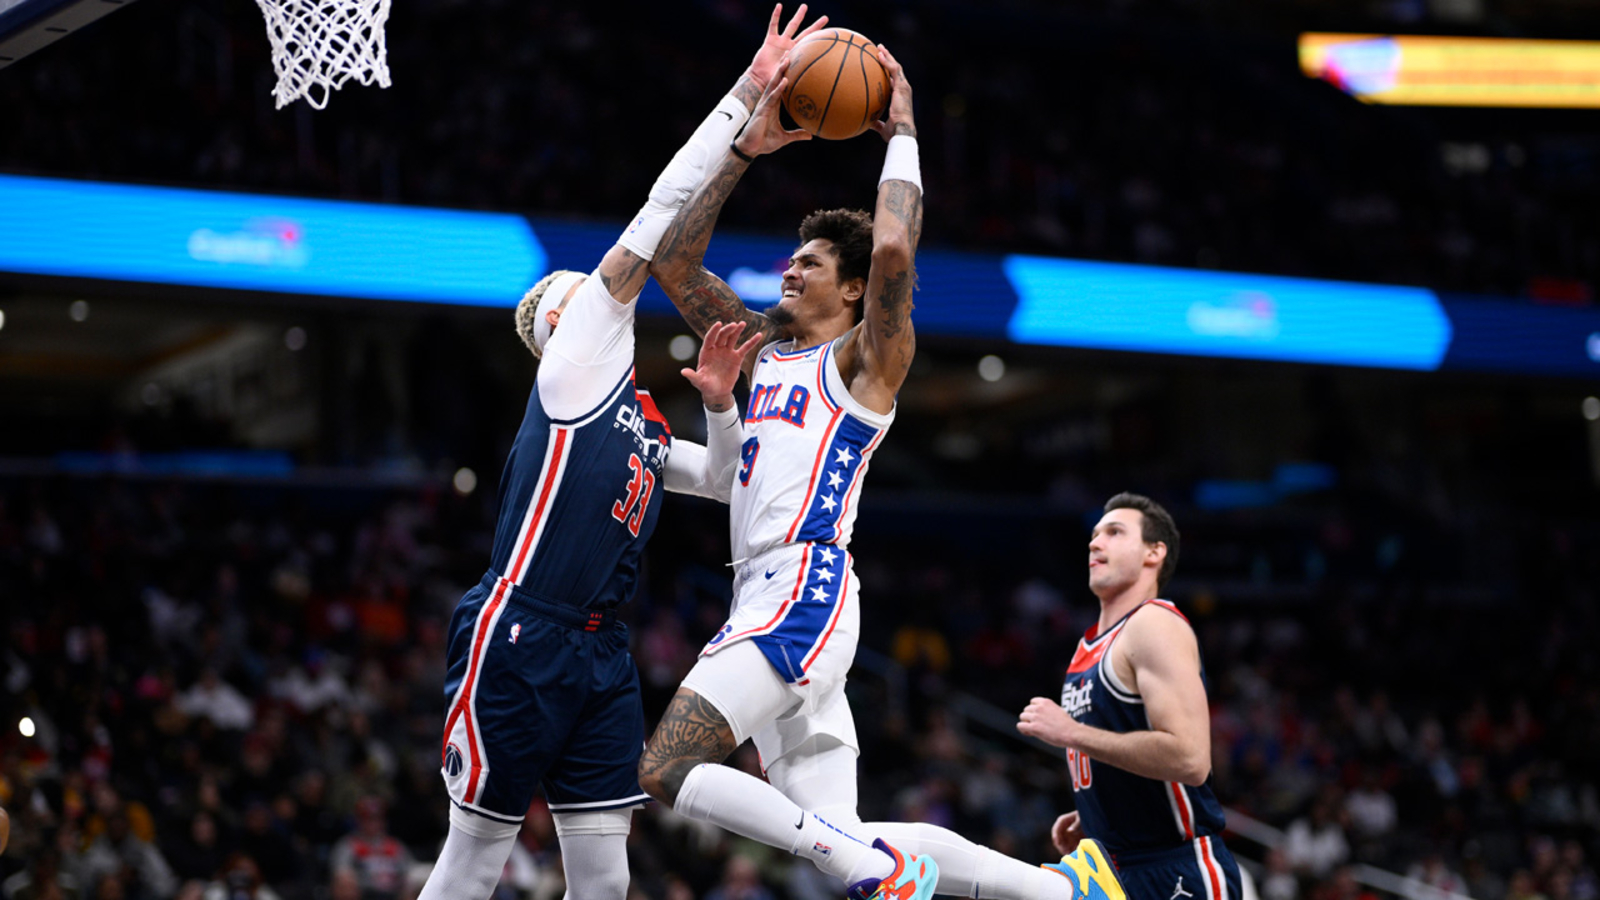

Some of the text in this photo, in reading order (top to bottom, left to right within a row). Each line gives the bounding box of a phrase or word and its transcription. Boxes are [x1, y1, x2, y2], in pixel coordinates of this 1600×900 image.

[745, 383, 811, 429] ILA
[739, 436, 760, 487] 9
[612, 453, 655, 538] 33
